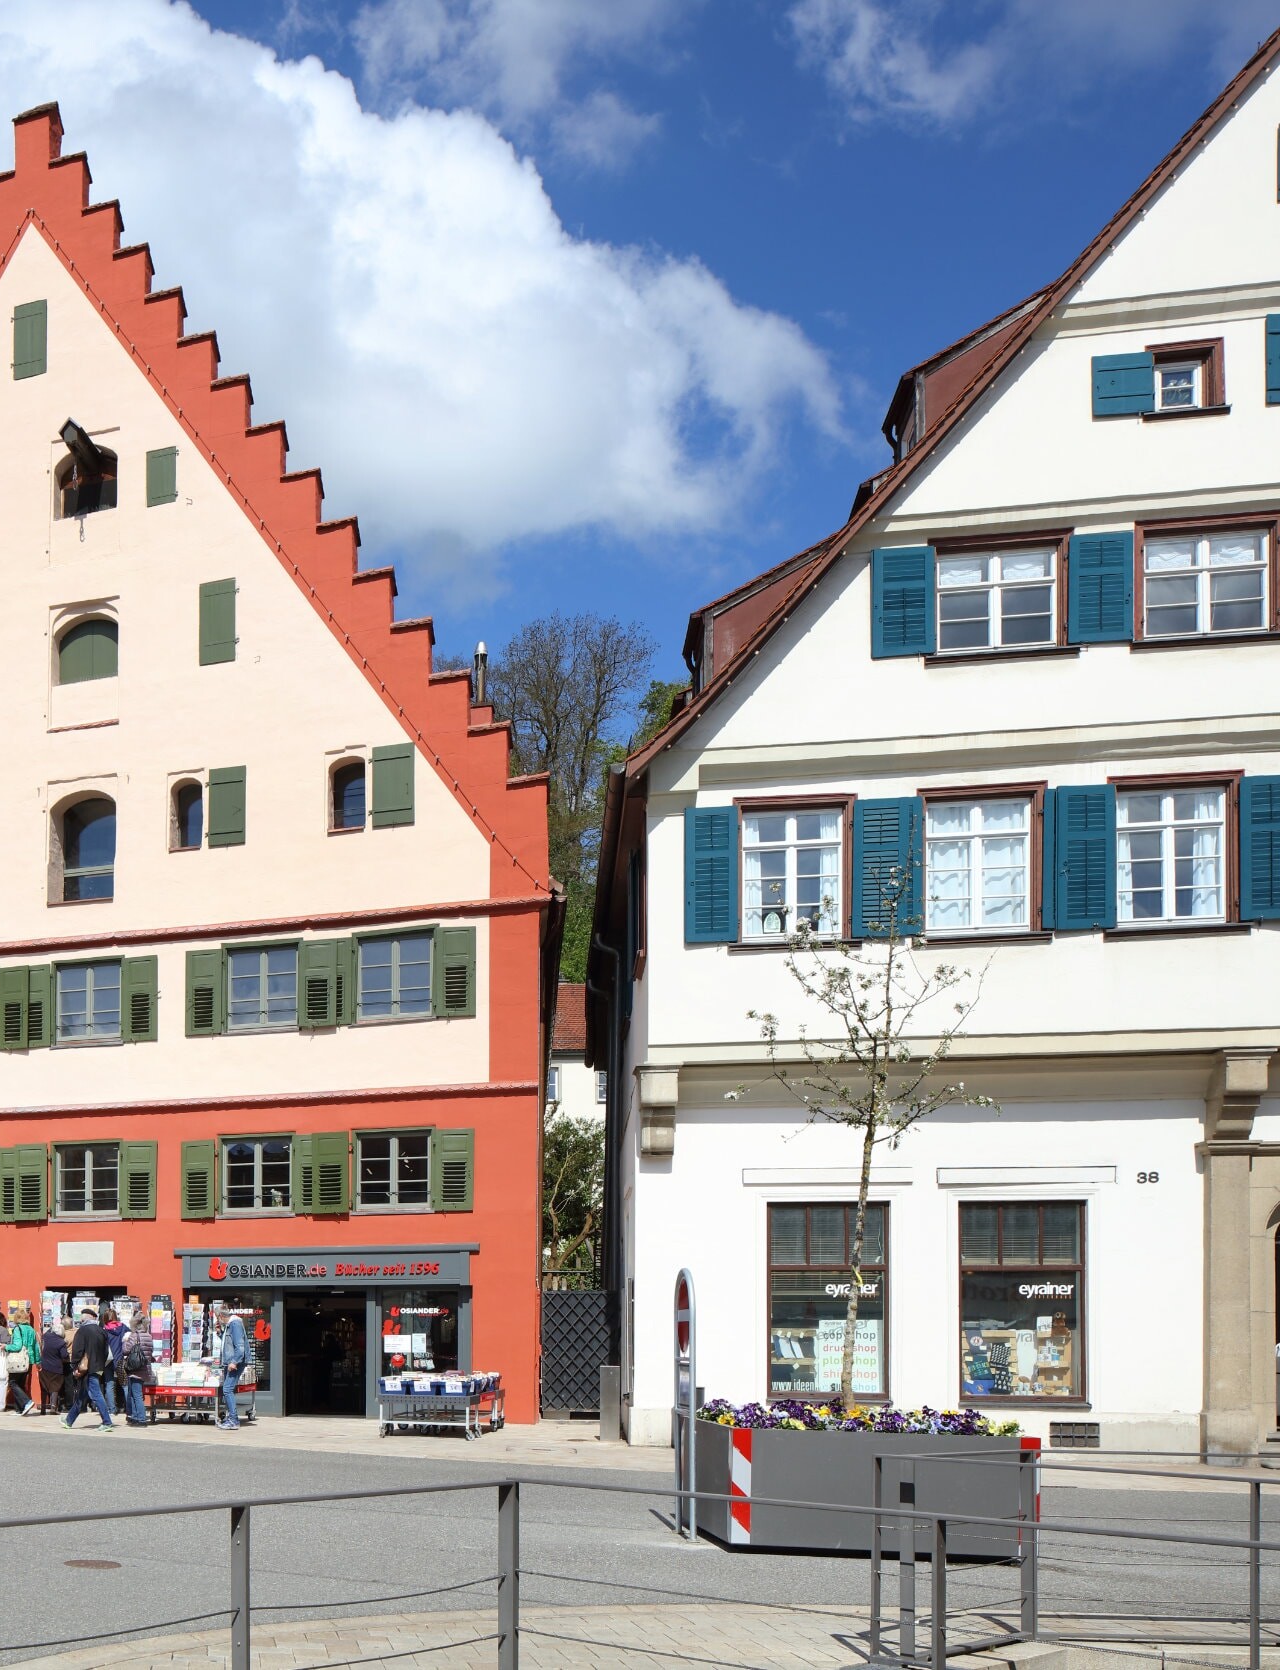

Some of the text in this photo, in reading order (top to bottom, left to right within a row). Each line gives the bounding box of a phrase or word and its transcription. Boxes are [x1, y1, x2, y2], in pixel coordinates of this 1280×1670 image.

[1137, 1171, 1160, 1184] 38
[229, 1262, 441, 1277] OSIANDER.de Bücher seit 1596
[825, 1283, 878, 1297] eyraer
[1018, 1281, 1074, 1299] eyrainer
